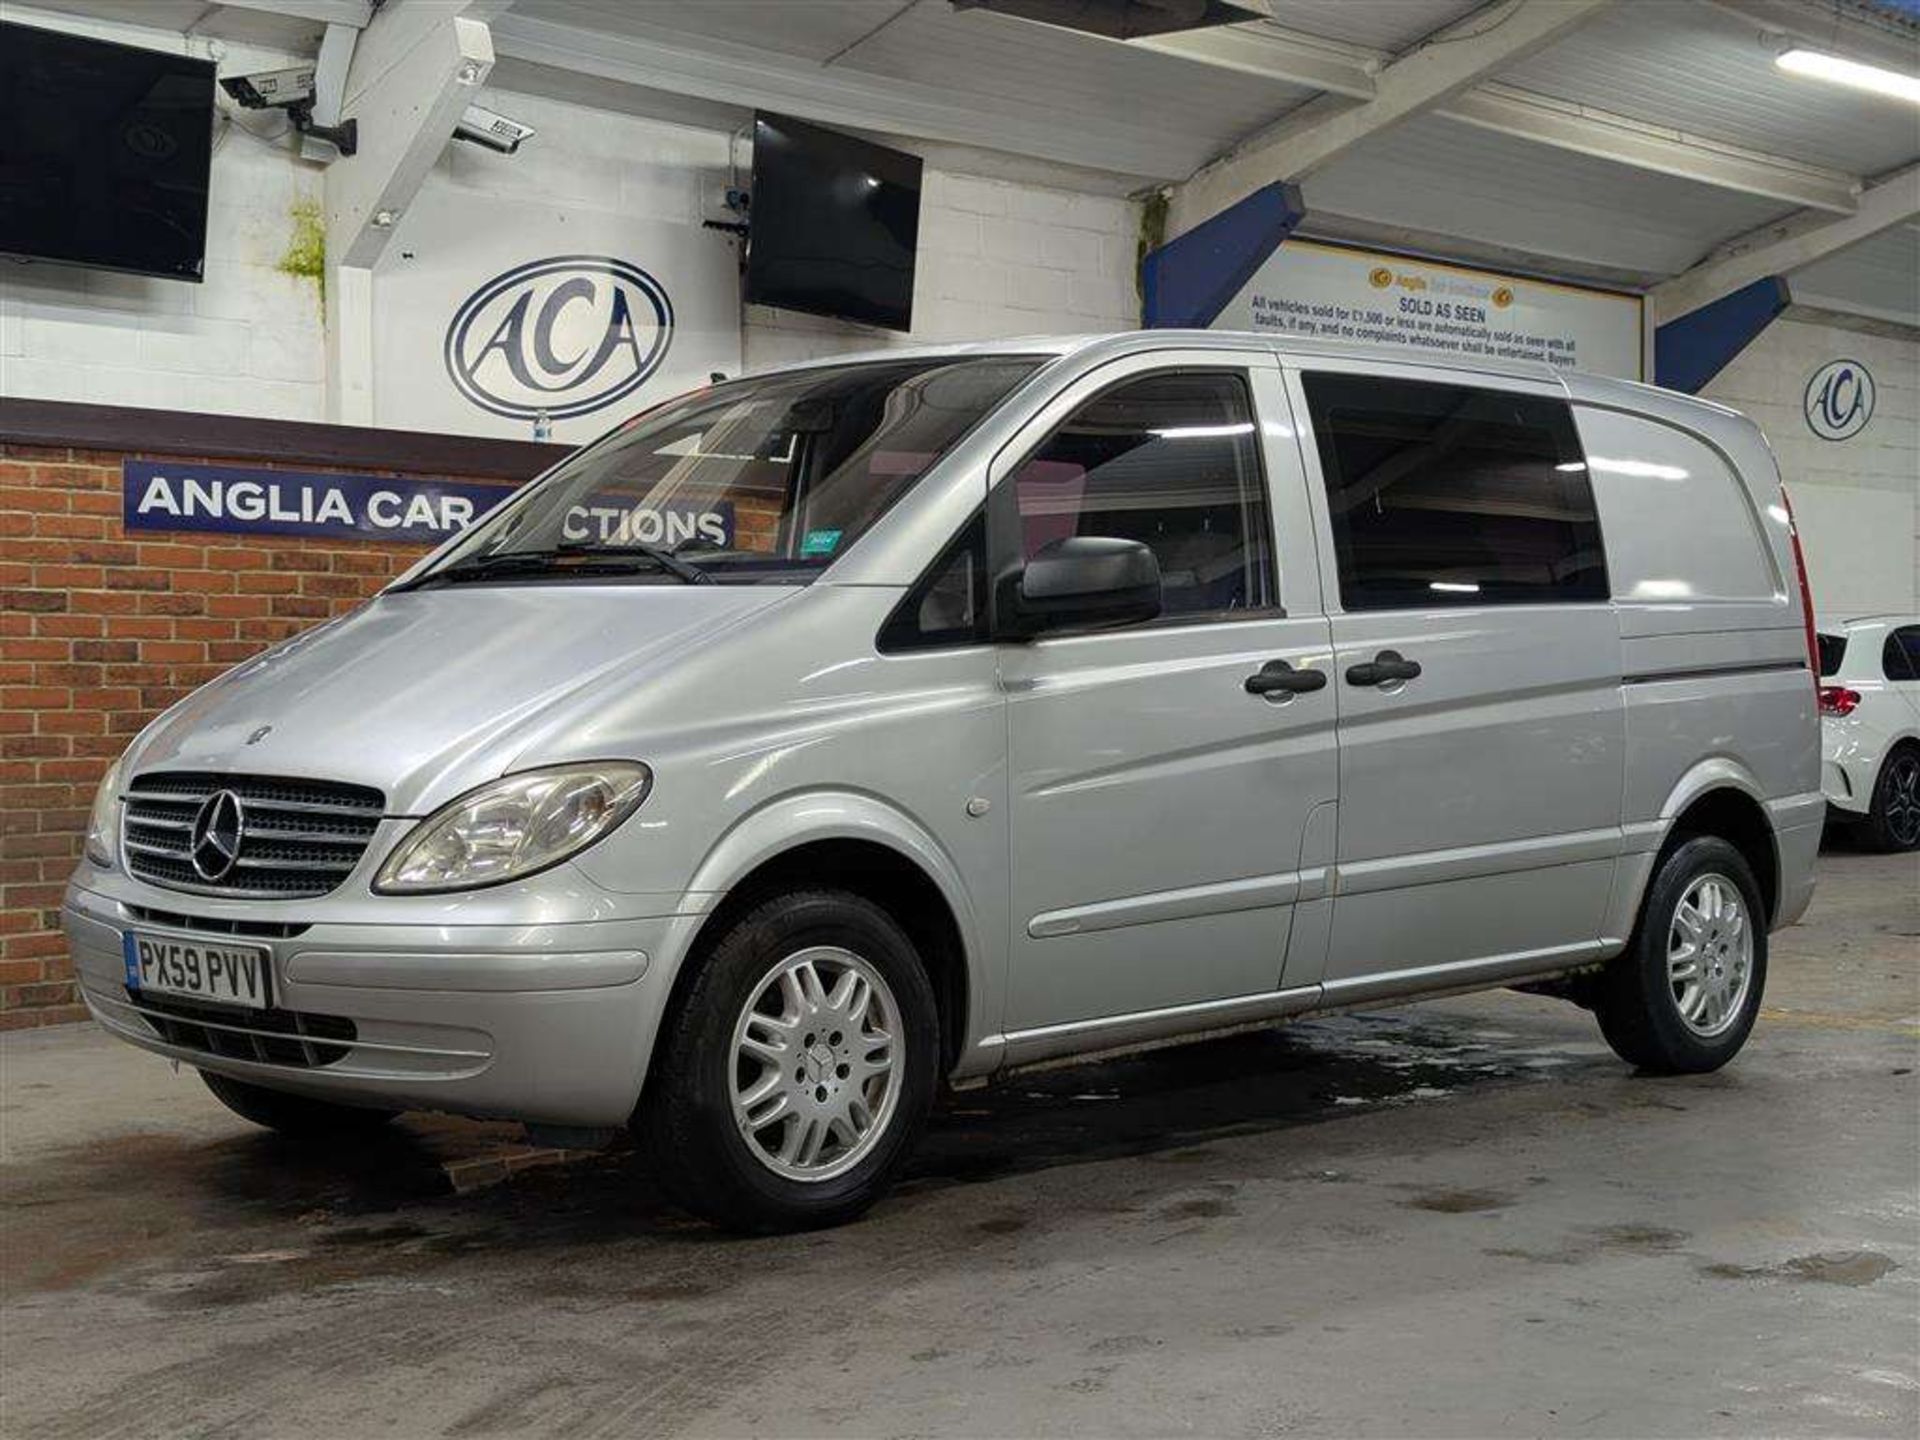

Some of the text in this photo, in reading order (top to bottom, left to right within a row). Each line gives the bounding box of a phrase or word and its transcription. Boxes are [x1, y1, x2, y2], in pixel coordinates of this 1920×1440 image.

[468, 277, 643, 393] ACA
[1252, 296, 1266, 308] All
[1268, 299, 1309, 314] vehicles
[1312, 305, 1334, 318] sold
[1336, 307, 1349, 320] for
[1385, 316, 1394, 325] or
[1397, 317, 1415, 329] less
[1418, 321, 1432, 331] are
[1434, 321, 1491, 342] automatically
[1494, 331, 1511, 343] sold
[1514, 335, 1524, 344] as
[1526, 336, 1545, 348] seen
[1547, 338, 1564, 350] with
[1400, 297, 1486, 323] SOLD AS SEEN
[1255, 312, 1286, 329] faults,
[1288, 316, 1296, 328] if
[1298, 320, 1318, 335] any,
[1321, 323, 1339, 334] and
[1342, 326, 1354, 336] no
[1356, 327, 1407, 344] complaints
[1409, 335, 1459, 350] whatsoever
[1462, 340, 1482, 353] shall
[1484, 343, 1495, 355] be
[1548, 351, 1576, 367] Buyers
[1810, 367, 1866, 430] ACA
[138, 477, 726, 546] ANGLIA CAR CTIONS
[139, 940, 257, 998] PX59 PVV
